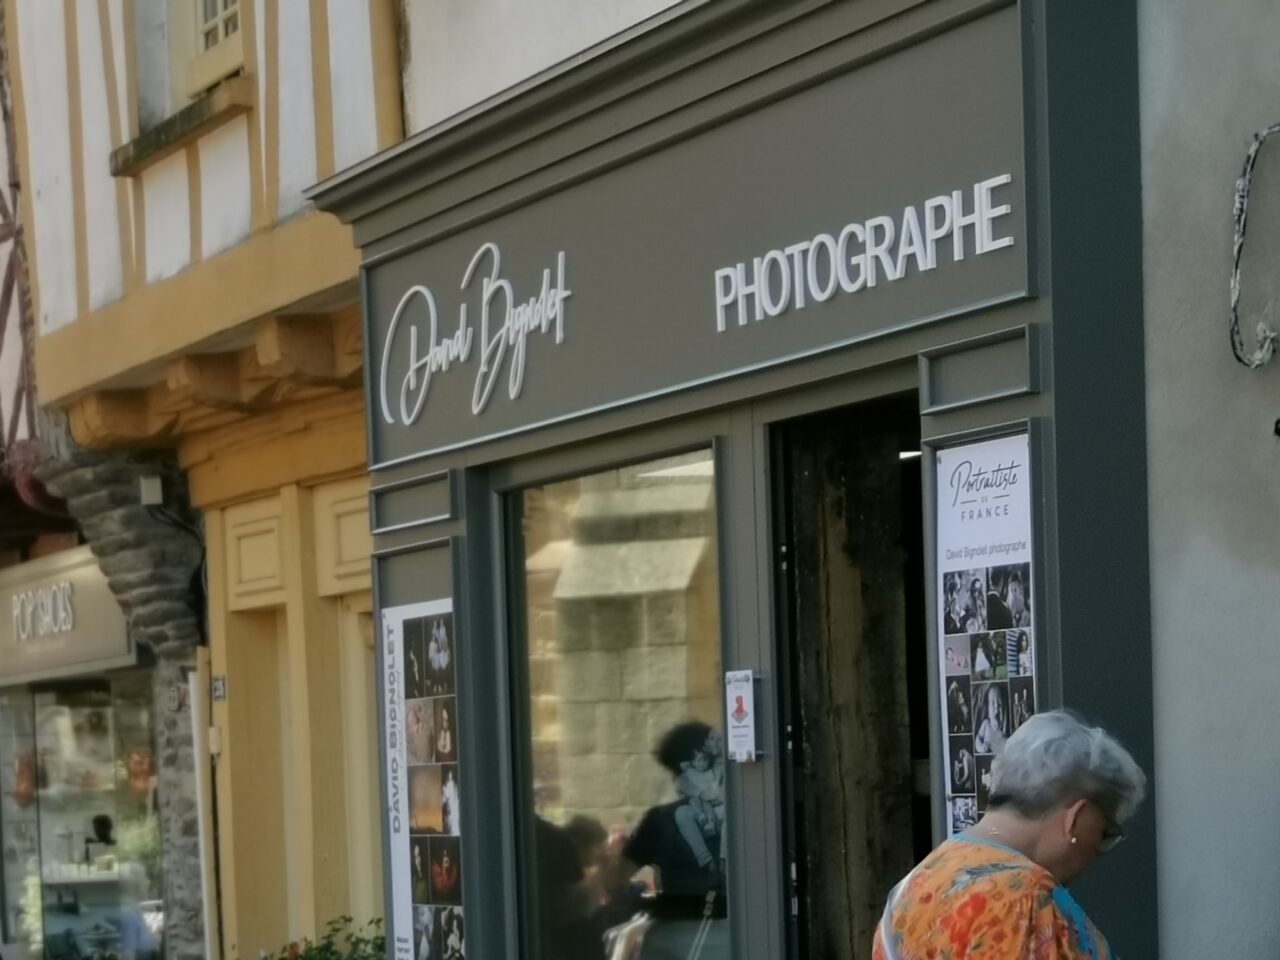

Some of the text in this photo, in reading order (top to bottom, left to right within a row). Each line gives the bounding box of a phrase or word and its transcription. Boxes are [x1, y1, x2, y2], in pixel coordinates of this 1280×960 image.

[715, 173, 1014, 332] PHOTOGRAPHE
[950, 460, 1023, 508] Portraitiste
[960, 504, 1010, 521] FRANCE
[946, 541, 1027, 560] David Bignolet photographe
[387, 623, 398, 749] BIGNOLET
[391, 757, 401, 834] DAVID
